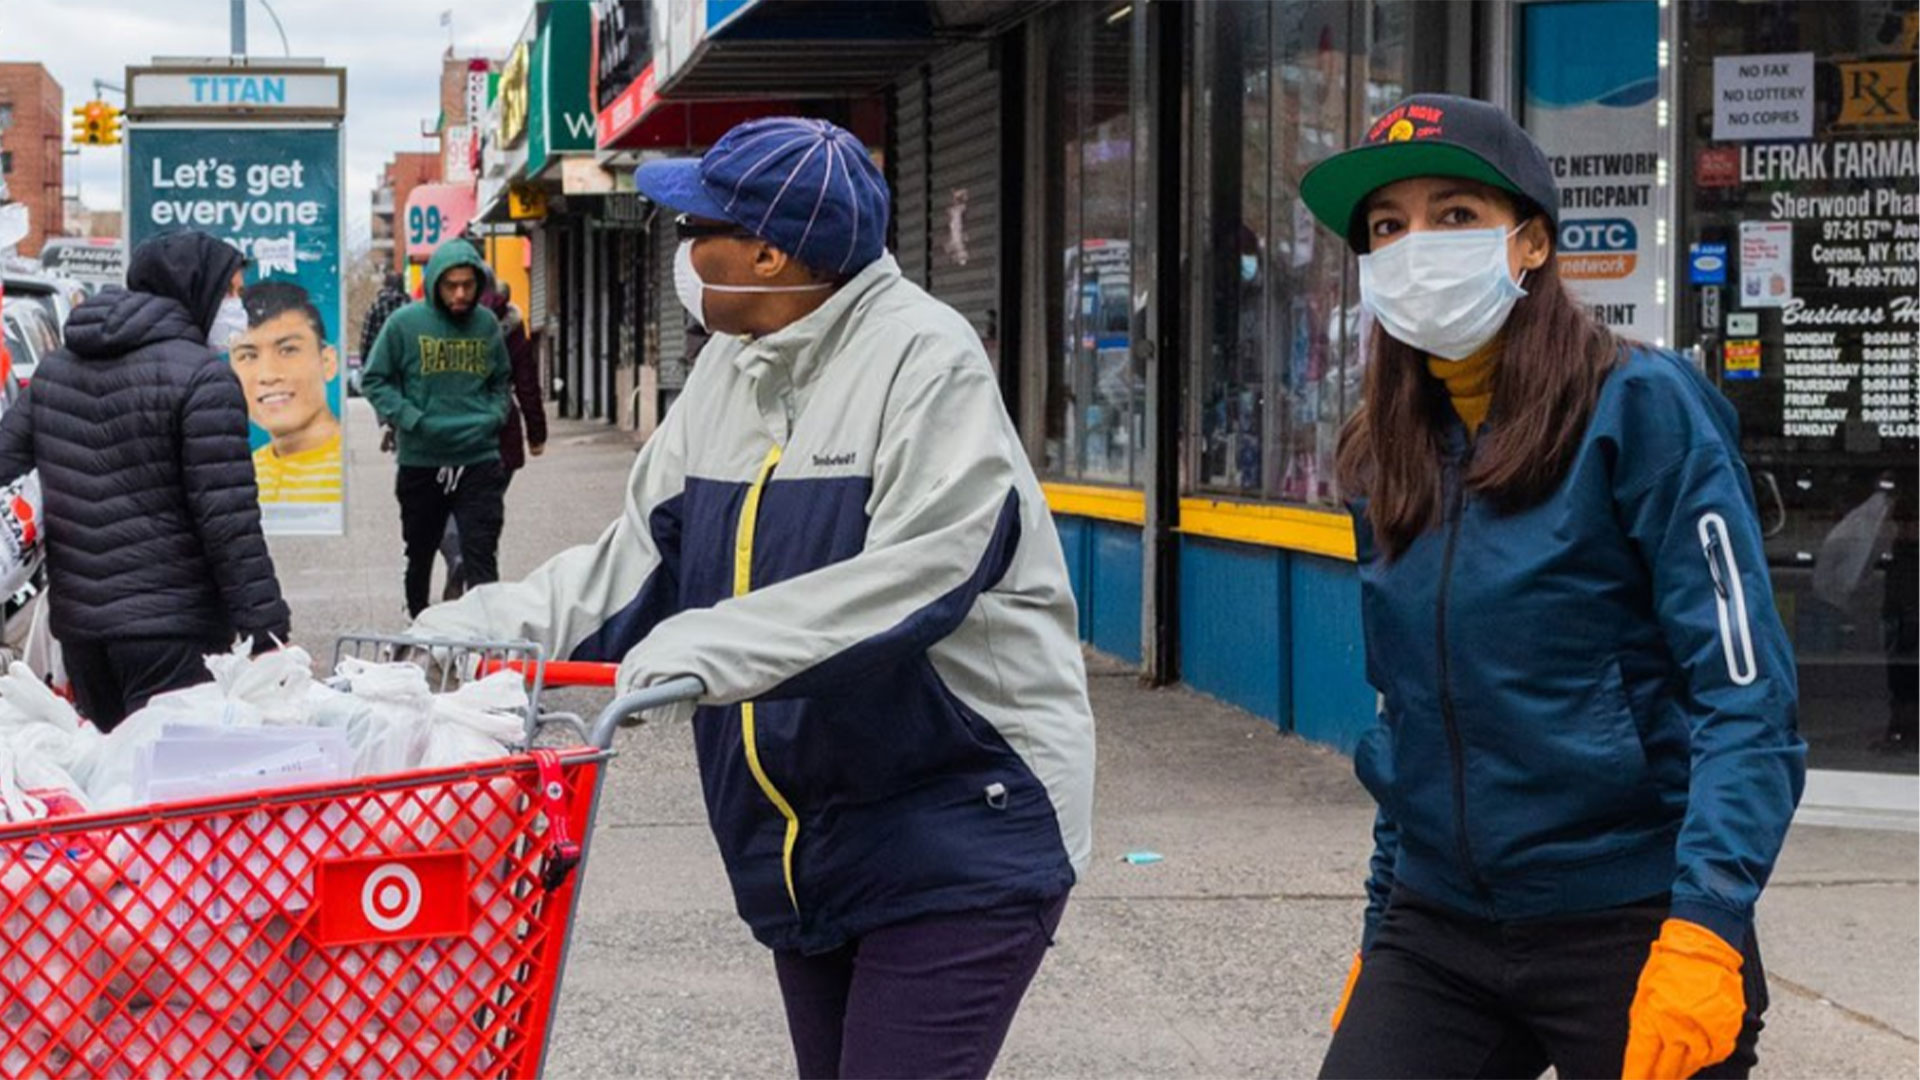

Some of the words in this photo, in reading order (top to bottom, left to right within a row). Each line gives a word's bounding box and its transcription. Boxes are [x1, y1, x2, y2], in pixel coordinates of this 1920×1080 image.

[1739, 65, 1760, 78] NO
[1763, 64, 1790, 77] FAX
[189, 77, 285, 102] TITAN
[1723, 89, 1744, 102] NO
[1749, 87, 1805, 101] LOTTERY
[1728, 113, 1749, 125] NO
[1753, 110, 1800, 124] COPIES
[1570, 152, 1658, 177] NETWORK
[1740, 143, 1827, 182] LEFRAK
[1834, 140, 1919, 179] FARMA
[152, 157, 236, 188] Let's
[246, 159, 305, 196] get
[1771, 189, 1870, 219] Sherwood
[151, 200, 319, 231] everyone
[1562, 225, 1628, 248] OTC
[1823, 220, 1859, 240] 97-21
[1862, 220, 1892, 239] 57th
[1812, 243, 1866, 266] Corona,
[1868, 242, 1891, 261] NY
[1561, 256, 1627, 273] network
[1826, 266, 1917, 287] 718-699-7700
[1781, 297, 1886, 325] Business
[1783, 332, 1836, 345] MONDAY
[1783, 347, 1842, 360] TUESDAY
[1783, 363, 1860, 376] WEDNESDAY
[1783, 378, 1849, 392] THURSDAY
[1783, 393, 1828, 406] FRIDAY
[1783, 408, 1848, 421] SATURDAY
[1783, 423, 1838, 436] SUNDAY
